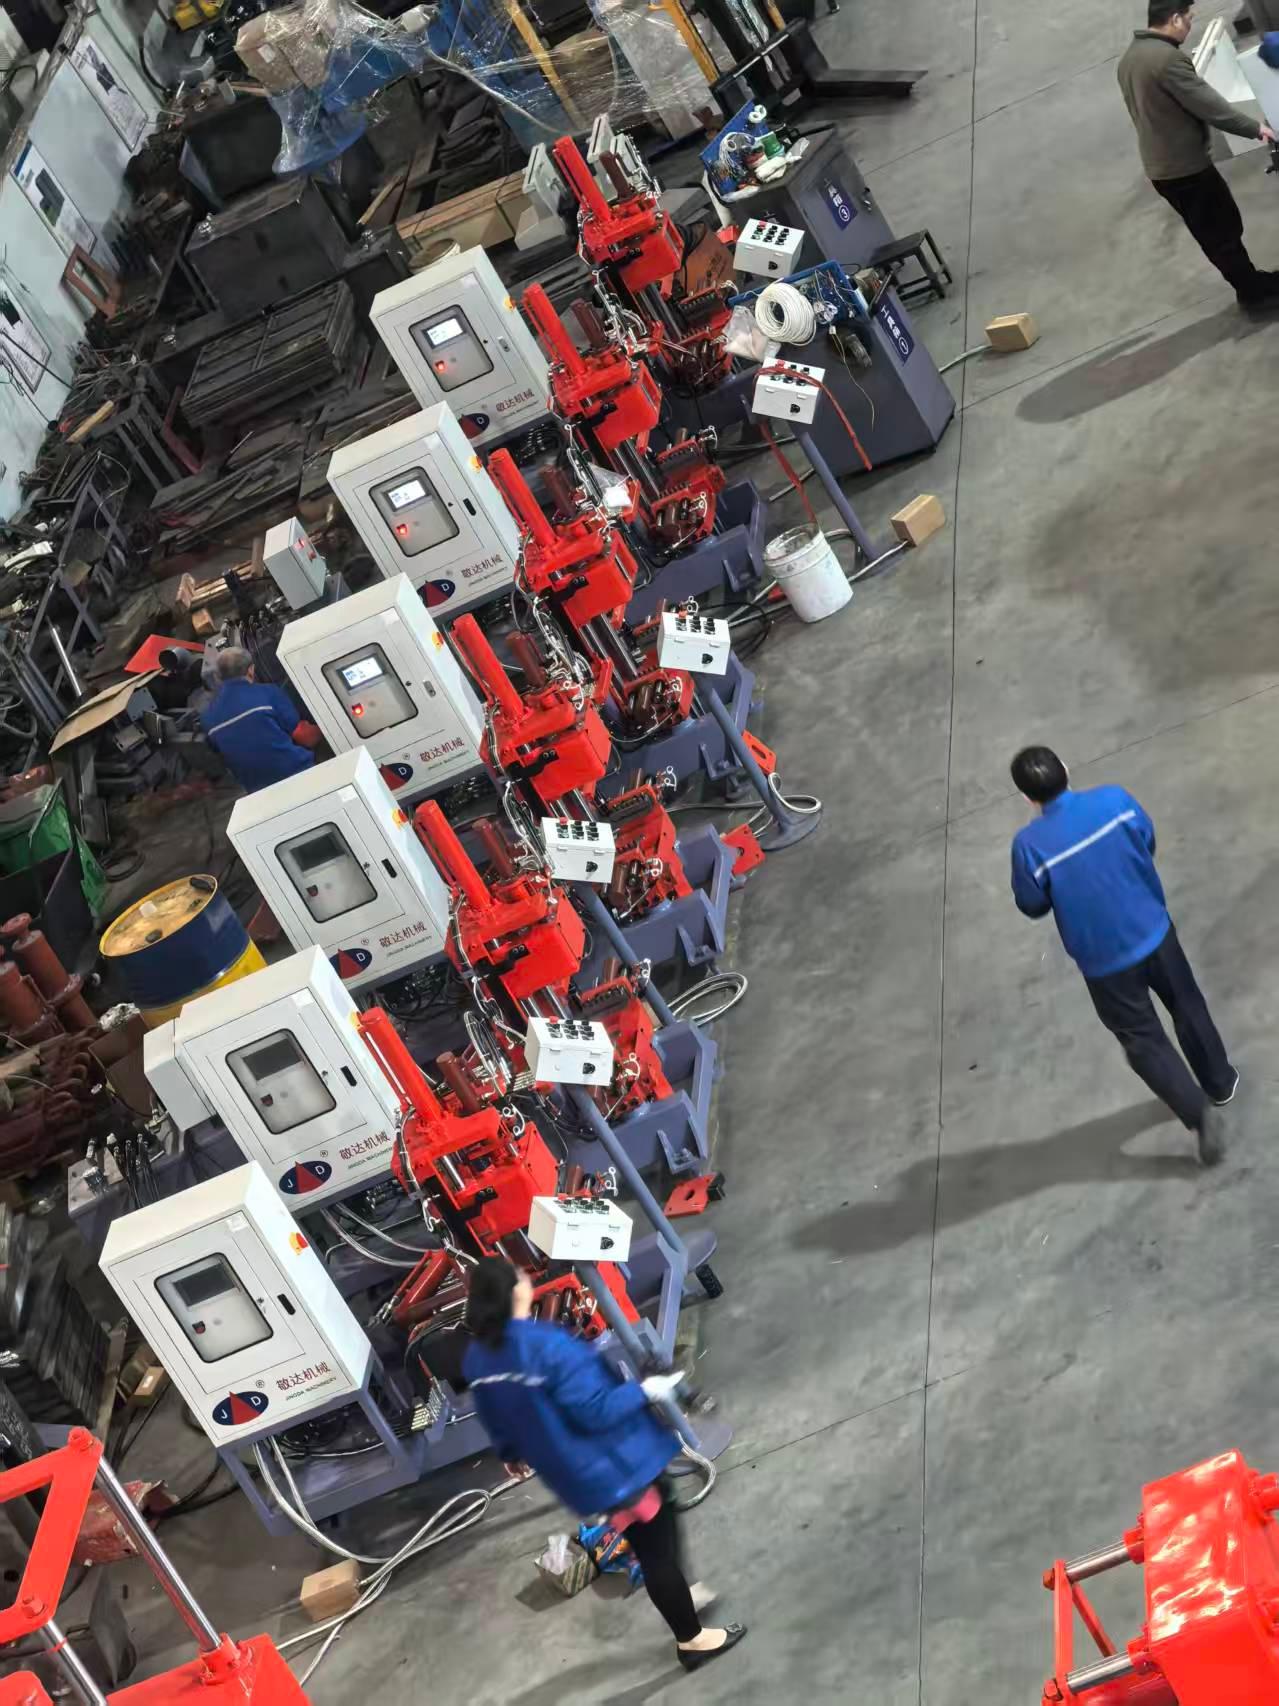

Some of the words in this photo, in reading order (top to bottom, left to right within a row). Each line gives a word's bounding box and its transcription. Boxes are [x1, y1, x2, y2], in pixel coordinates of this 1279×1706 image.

[441, 583, 450, 592] D
[419, 737, 465, 761] 敬达机械
[398, 766, 407, 775] D
[379, 920, 427, 948] 敬达机械
[356, 952, 366, 962] D
[339, 1130, 391, 1160] 敬达机械
[276, 1361, 331, 1391] 敬达机械
